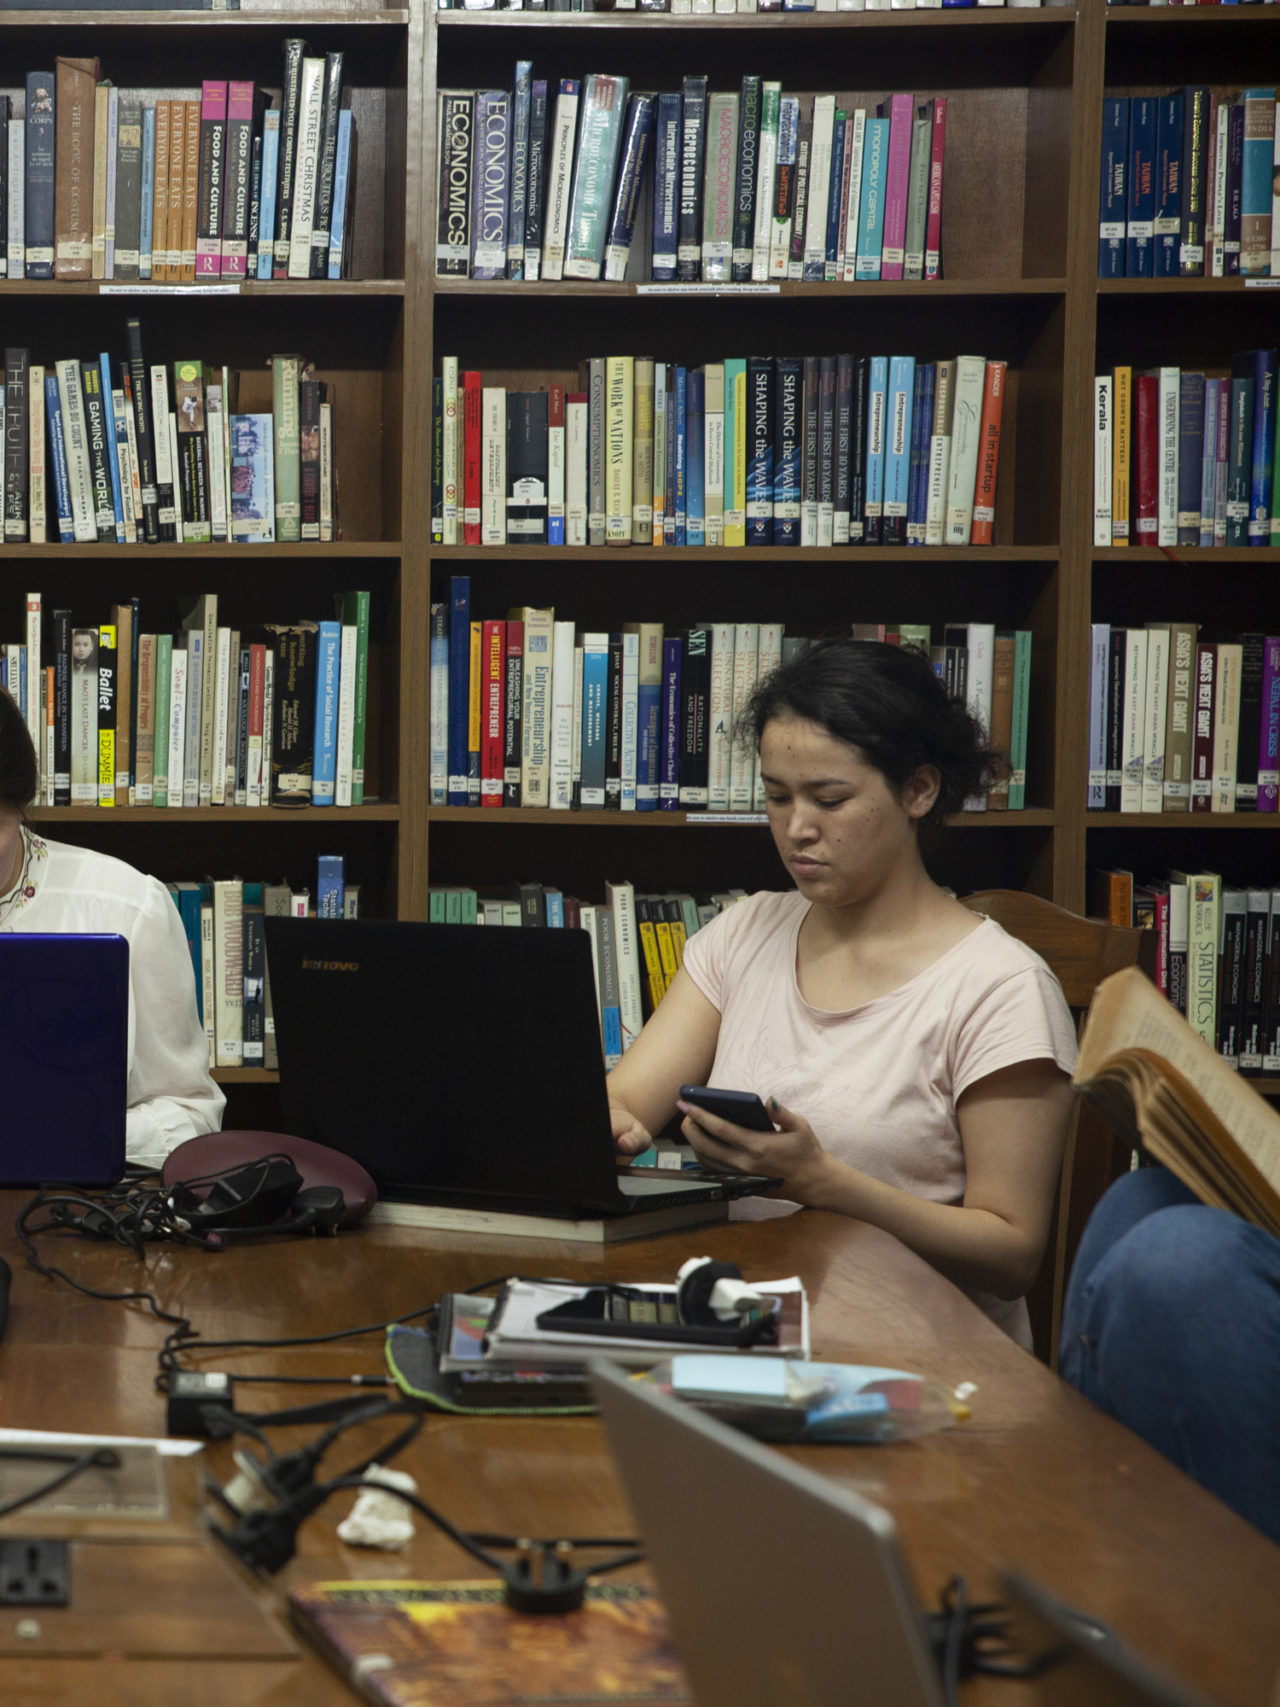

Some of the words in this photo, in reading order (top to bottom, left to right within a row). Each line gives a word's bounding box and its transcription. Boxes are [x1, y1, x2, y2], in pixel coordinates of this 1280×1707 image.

[157, 106, 168, 171] EVERYONE
[172, 106, 183, 171] EVERYONE
[187, 106, 198, 171] EVERYONE
[212, 126, 222, 157] FOOD
[239, 126, 248, 157] FOOD
[778, 103, 794, 163] macroeconomics
[1248, 125, 1273, 133] INDIA
[739, 81, 760, 211] macroeconomics
[211, 160, 220, 184] AND
[238, 160, 246, 184] AND
[448, 100, 470, 245] ECONOMICS
[483, 101, 507, 241] ECONOMICS
[682, 118, 700, 215] Macroeconomics
[716, 109, 732, 235] MACROECONOMICS
[1114, 163, 1123, 195] TAIWAN
[1141, 162, 1151, 194] TAIWAN
[1169, 160, 1178, 193] TAIWAN
[156, 177, 167, 208] EATS
[171, 177, 181, 208] EATS
[186, 177, 197, 208] EATS
[210, 187, 220, 235] CULTURE
[236, 187, 246, 235] CULTURE
[7, 356, 25, 397] THE
[65, 365, 75, 382] THE
[615, 362, 624, 377] THE
[1119, 373, 1127, 390] WHY
[67, 384, 78, 406] GAMES
[278, 360, 298, 438] Running
[610, 378, 623, 408] WORK
[677, 376, 685, 404] Michael
[755, 374, 767, 435] SHAPING
[69, 409, 79, 419] DO
[677, 406, 685, 425] Albert
[872, 393, 882, 453] Entrepreneurship
[896, 393, 906, 453] Entrepreneurship
[1098, 384, 1108, 430] Kerala
[1119, 392, 1127, 425] GROWTH
[7, 404, 24, 470] TRUTH
[71, 421, 82, 449] COUNT
[592, 374, 605, 486] CONSUMPTIONOMICS
[610, 418, 624, 464] NATIONS
[1119, 428, 1127, 465] MATTERS
[755, 439, 767, 458] the
[688, 630, 706, 656] SEN
[1176, 632, 1191, 668] ASIA'S
[288, 642, 297, 692] knowledge
[712, 651, 723, 715] SELECTION
[724, 650, 732, 713] UNNATURAL
[1200, 652, 1213, 682] ASIA'S
[99, 667, 113, 711] Ballet
[1174, 670, 1189, 699] NEXT
[1199, 684, 1212, 708] NEXT
[1269, 676, 1280, 708] NEPAL
[531, 665, 549, 766] Entrepreneurship
[686, 695, 694, 711] AND
[1173, 701, 1188, 733] GIANT
[686, 715, 694, 753] FREEDOM
[1197, 710, 1210, 738] GIANT
[1267, 725, 1278, 757] CRISIS
[224, 890, 242, 917] BOB
[1160, 905, 1168, 918] The
[602, 917, 613, 941] POOR
[622, 915, 630, 956] ECONOMICS
[1160, 920, 1168, 966] Information
[224, 920, 243, 997] WOODWARD
[602, 944, 613, 1001] ECONOMICS
[1160, 969, 1168, 988] Diet
[1170, 955, 1183, 1008] Economy
[1197, 941, 1215, 1025] STATISTICS
